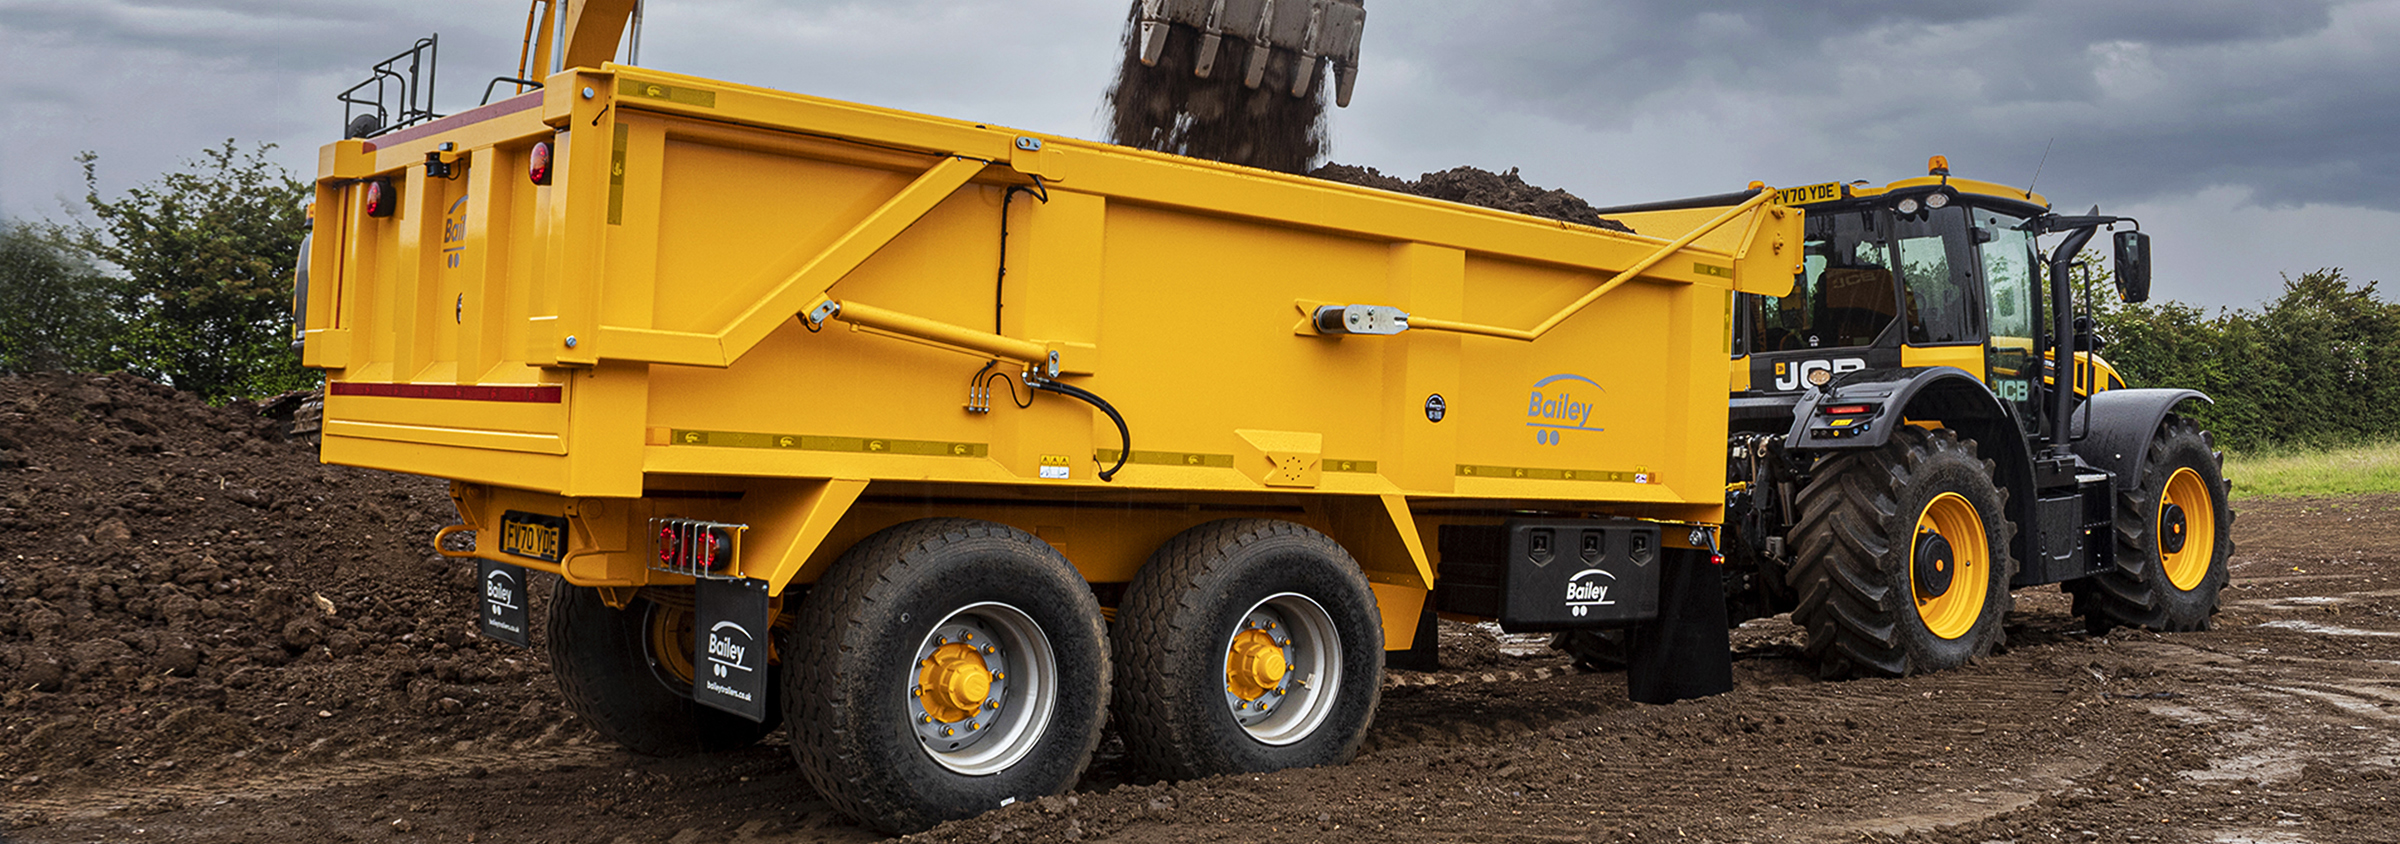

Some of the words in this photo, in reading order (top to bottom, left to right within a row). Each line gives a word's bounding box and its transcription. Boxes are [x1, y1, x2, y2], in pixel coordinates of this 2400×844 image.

[1774, 187, 1806, 204] FV70
[1809, 183, 1835, 200] YDE
[444, 214, 467, 243] Bail
[1833, 271, 1877, 289] JCB
[1991, 380, 2028, 401] JCB
[1527, 391, 1593, 428] Bailey
[507, 523, 534, 550] FV70
[536, 528, 557, 555] YDE
[487, 580, 512, 605] Bailey
[1566, 581, 1608, 602] Bailey
[708, 633, 745, 666] Bailey
